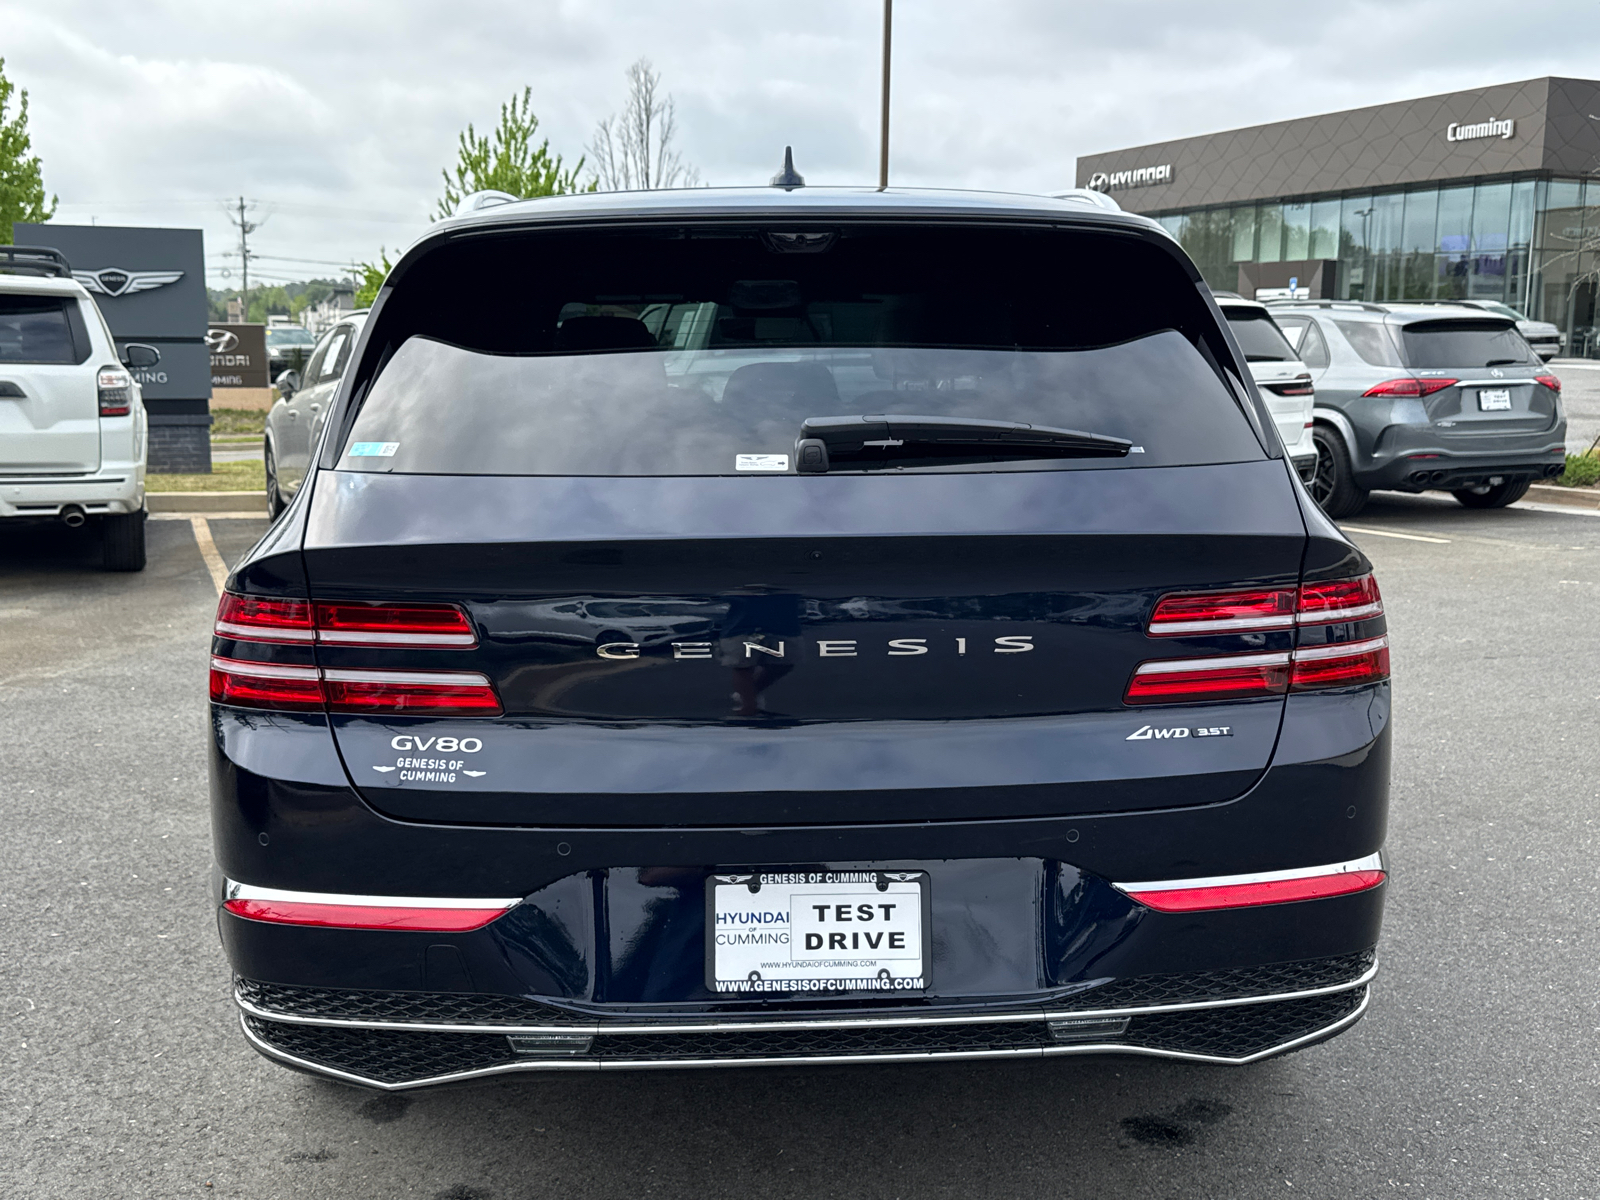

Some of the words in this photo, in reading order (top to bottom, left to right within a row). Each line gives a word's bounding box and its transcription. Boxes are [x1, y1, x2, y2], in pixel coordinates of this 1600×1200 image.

[1447, 117, 1514, 141] Cumming
[1110, 164, 1171, 186] HYUNDAI
[596, 635, 1035, 660] GENESIS
[1126, 725, 1190, 740] 4WD
[391, 735, 483, 753] GV80
[396, 757, 446, 770] GENESIS
[449, 760, 464, 771] OF
[399, 770, 456, 783] CUMMING
[760, 873, 807, 884] GENESIS
[808, 873, 823, 883] OF
[825, 872, 878, 883] CUMMING
[716, 911, 790, 925] HYUNDAI
[812, 904, 897, 922] TEST
[716, 932, 790, 945] CUMMING
[805, 931, 906, 950] DRIVE
[760, 960, 877, 969] WWW.HYUNDAIOFCUMMING.COM
[715, 978, 924, 992] WWW.GENESISOFCUMMING.COM
